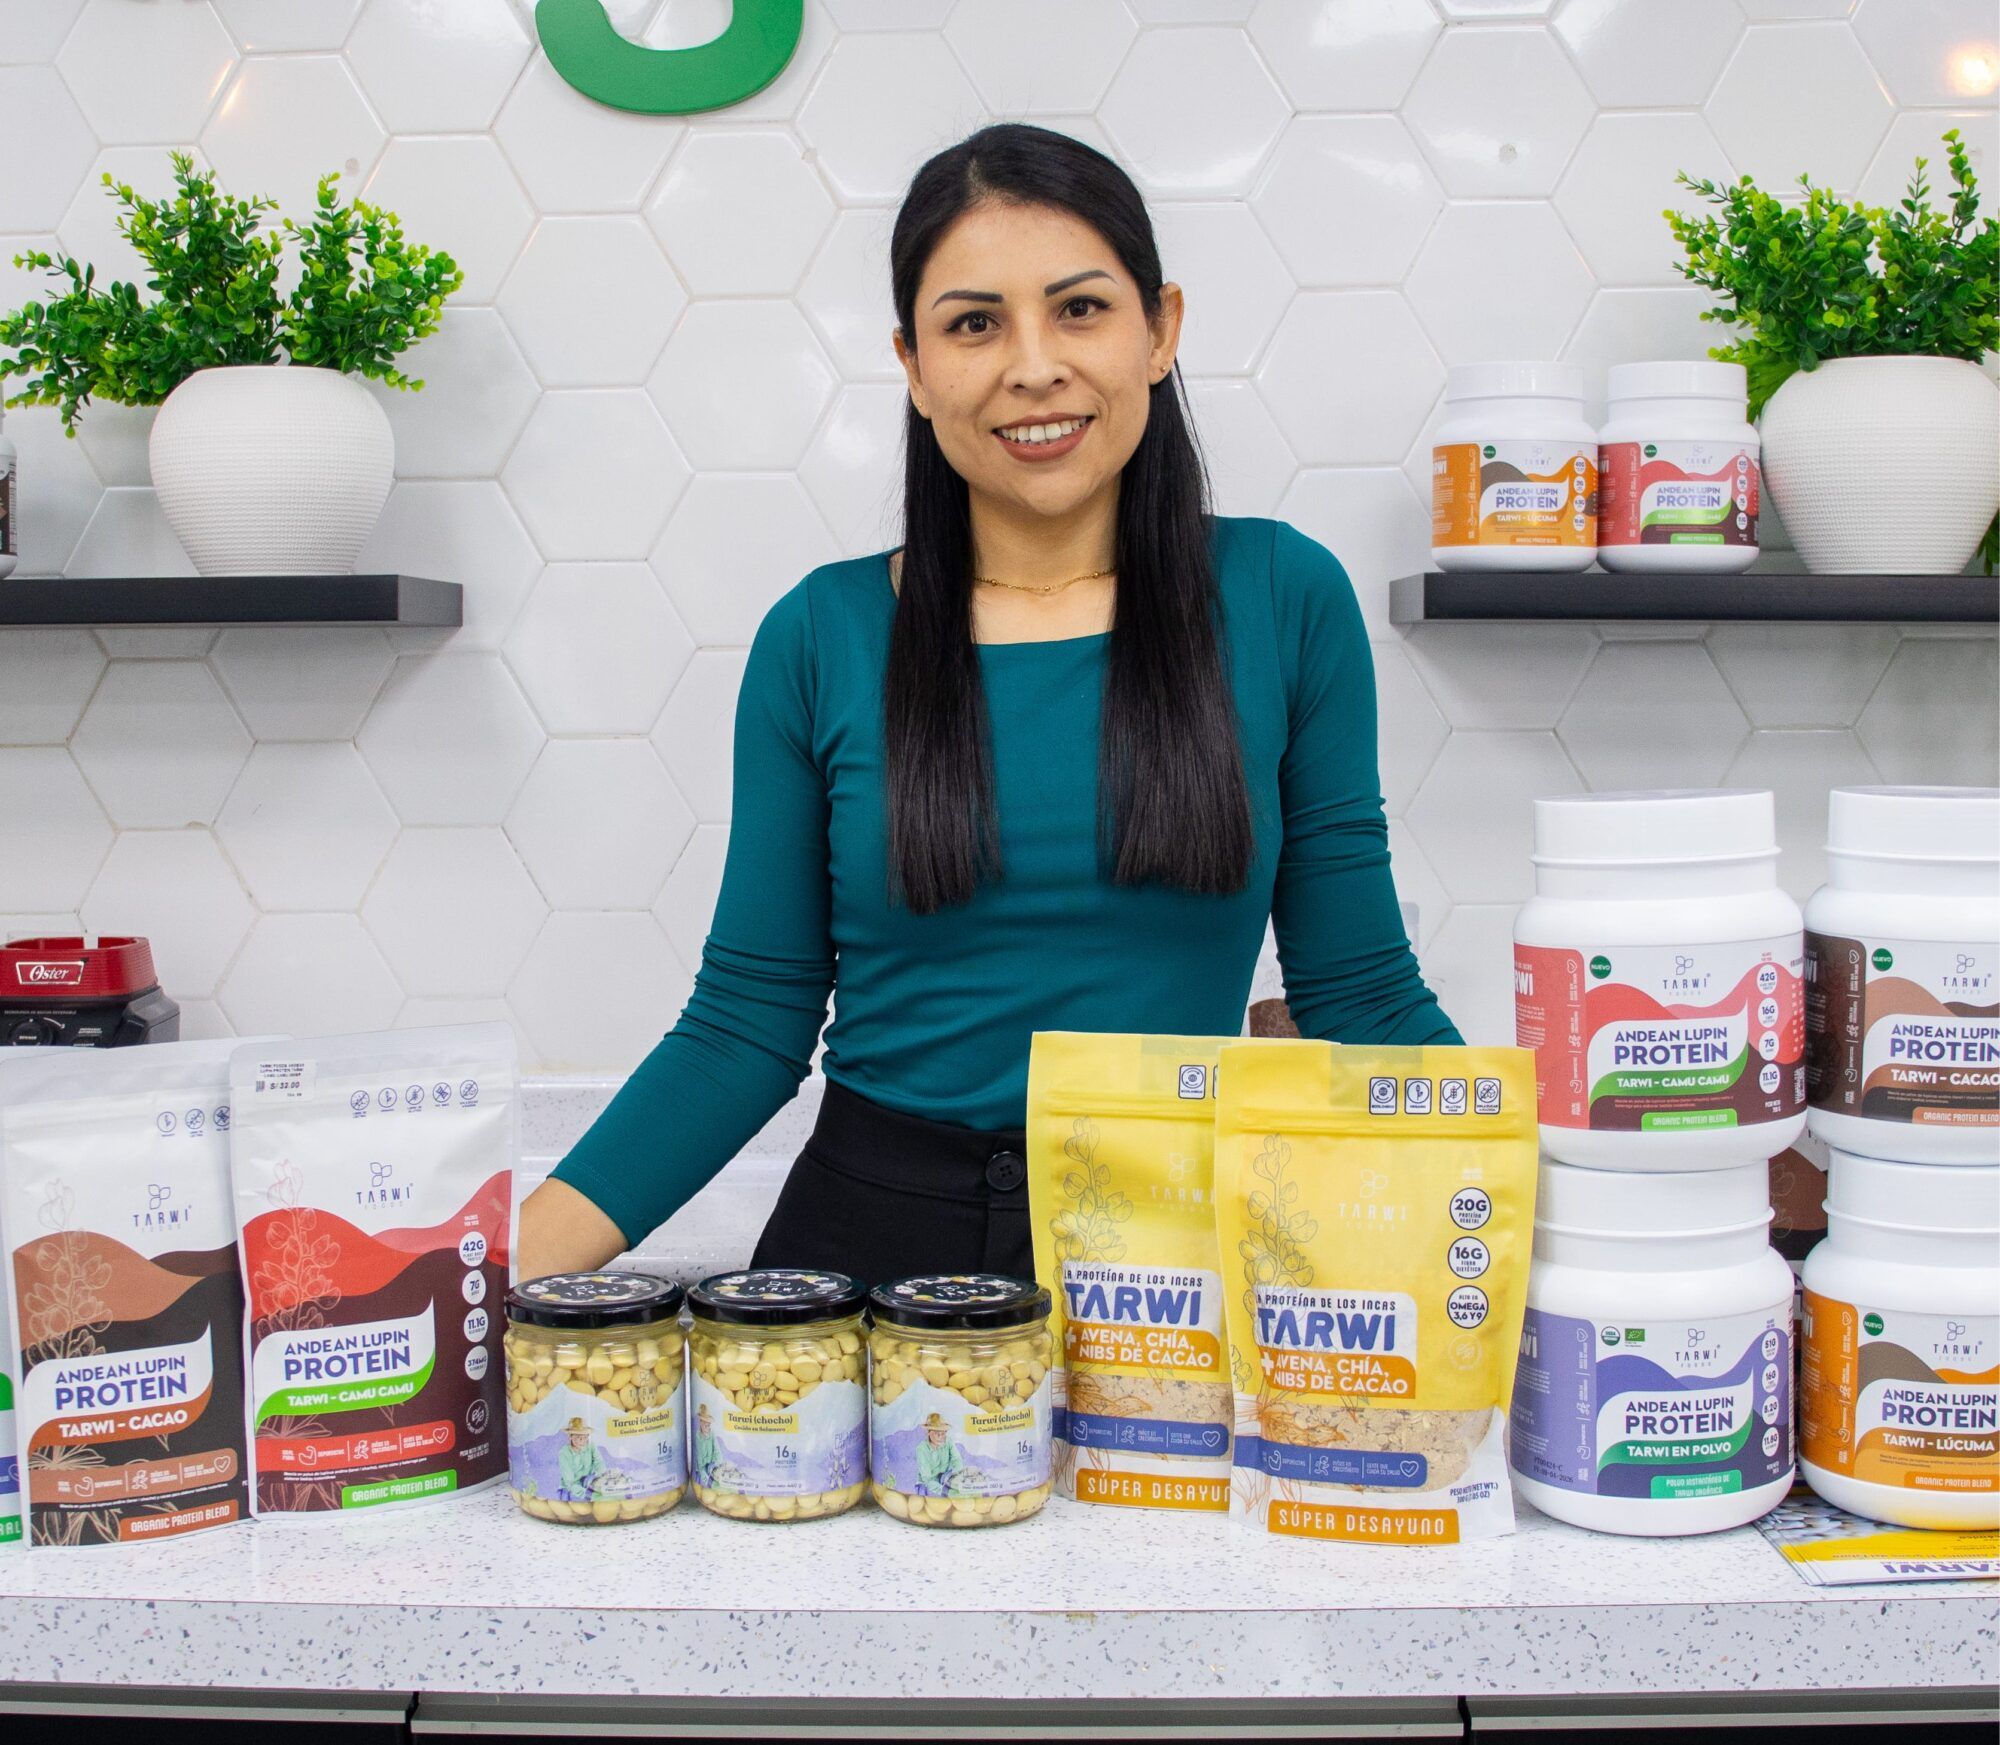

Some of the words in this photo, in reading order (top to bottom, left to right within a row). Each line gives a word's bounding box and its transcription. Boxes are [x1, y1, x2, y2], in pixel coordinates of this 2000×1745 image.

[1496, 488, 1534, 496] ANDEAN
[1536, 488, 1558, 496] LUPIN
[1496, 496, 1558, 508] PROTEIN
[1656, 496, 1720, 506] PROTEIN
[29, 965, 69, 981] Oster
[1760, 972, 1775, 982] 42G
[1663, 978, 1707, 989] TARWI
[1942, 976, 1987, 988] TARWI
[1762, 1006, 1775, 1014] 16G
[1615, 1030, 1680, 1042] ANDEAN
[1685, 1027, 1727, 1041] LUPIN
[1892, 1024, 1956, 1038] ANDEAN
[1765, 1039, 1774, 1048] 7G
[1890, 1038, 2000, 1062] PROTEIN
[1615, 1042, 1728, 1065] PROTEIN
[1617, 1078, 1652, 1088] TARWI
[1662, 1076, 1695, 1087] CAMU
[1698, 1074, 1730, 1086] CAMU
[1891, 1069, 1937, 1084] TARWI
[1950, 1074, 2000, 1086] CACAO
[357, 1186, 410, 1204] TARWI
[1340, 1203, 1407, 1222] TARWI
[1455, 1199, 1486, 1212] 20G
[133, 1208, 189, 1227] TARWI
[463, 1240, 484, 1252] 42G
[1455, 1247, 1482, 1260] 16G
[470, 1280, 480, 1291] 7G
[1077, 1269, 1124, 1282] PROTEÍNA
[1130, 1274, 1141, 1283] DE
[1148, 1274, 1165, 1284] LOS
[1171, 1276, 1202, 1287] INCAS
[1065, 1283, 1201, 1326] TARWI
[1266, 1293, 1316, 1308] PROTEÍNA
[1321, 1298, 1332, 1308] DE
[1337, 1299, 1356, 1309] LOS
[1362, 1300, 1396, 1310] INCAS
[1450, 1302, 1485, 1310] OMEGA
[468, 1316, 486, 1329] 11.1G
[1454, 1312, 1468, 1320] 3,6
[1258, 1308, 1396, 1351] TARWI
[284, 1336, 358, 1355] ANDEAN
[363, 1329, 410, 1348] LUPIN
[1081, 1328, 1140, 1347] AVENA,
[1146, 1326, 1194, 1350] CHÍA,
[1080, 1345, 1116, 1360] NIBS
[1120, 1350, 1142, 1362] DE
[1148, 1350, 1212, 1368] CACAO
[1676, 1349, 1716, 1362] TARWI
[1934, 1344, 1978, 1354] TARWI
[56, 1366, 130, 1384] ANDEAN
[136, 1356, 186, 1374] LUPIN
[285, 1346, 410, 1380] PROTEIN
[1277, 1354, 1332, 1375] AVENA,
[1337, 1356, 1390, 1376] CHÍA,
[56, 1373, 187, 1410] PROTEIN
[1274, 1374, 1306, 1388] NIBS
[1311, 1374, 1334, 1390] DE
[1340, 1377, 1408, 1394] CACAO
[288, 1392, 328, 1406] TARWI
[340, 1388, 376, 1403] CAMU
[379, 1383, 414, 1398] CAMU
[1883, 1389, 1948, 1405] ANDEAN
[1952, 1394, 1996, 1406] LUPIN
[1626, 1400, 1690, 1412] ANDEAN
[1695, 1396, 1734, 1411] LUPIN
[613, 1417, 639, 1428] Tarwi
[640, 1411, 670, 1426] (chocho)
[728, 1414, 752, 1423] Tarwi
[754, 1416, 792, 1424] (chocho)
[971, 1416, 997, 1425] Tarwi
[999, 1410, 1030, 1424] (chocho)
[1626, 1411, 1733, 1434] PROTEIN
[1882, 1402, 1996, 1428] PROTEIN
[59, 1420, 114, 1438] TARWI
[130, 1410, 188, 1430] CACAO
[658, 1440, 668, 1454] 16
[1018, 1440, 1028, 1454] 16
[1029, 1446, 1032, 1454] g
[1627, 1446, 1670, 1457] TARWI
[1672, 1446, 1690, 1456] EN
[1692, 1442, 1732, 1456] POLVO
[1882, 1433, 1924, 1448] TARWI
[1936, 1434, 1995, 1452] LÚCUMA
[776, 1446, 789, 1458] 16
[792, 1452, 796, 1460] g
[352, 1486, 389, 1502] ORGANIC
[390, 1480, 423, 1496] PROTEIN
[425, 1476, 448, 1492] BLEND
[1088, 1473, 1141, 1498] SÚPER
[1152, 1483, 1230, 1502] DESAYUN
[1916, 1476, 1944, 1486] ORGANIC
[1945, 1478, 1970, 1488] PROTEIN
[1972, 1480, 1992, 1488] BLEND
[131, 1518, 170, 1532] ORGANIC
[172, 1512, 204, 1528] PROTEIN
[206, 1506, 230, 1520] BLEND
[1280, 1504, 1335, 1530] SÚPER
[1346, 1514, 1444, 1536] DESAYUNO
